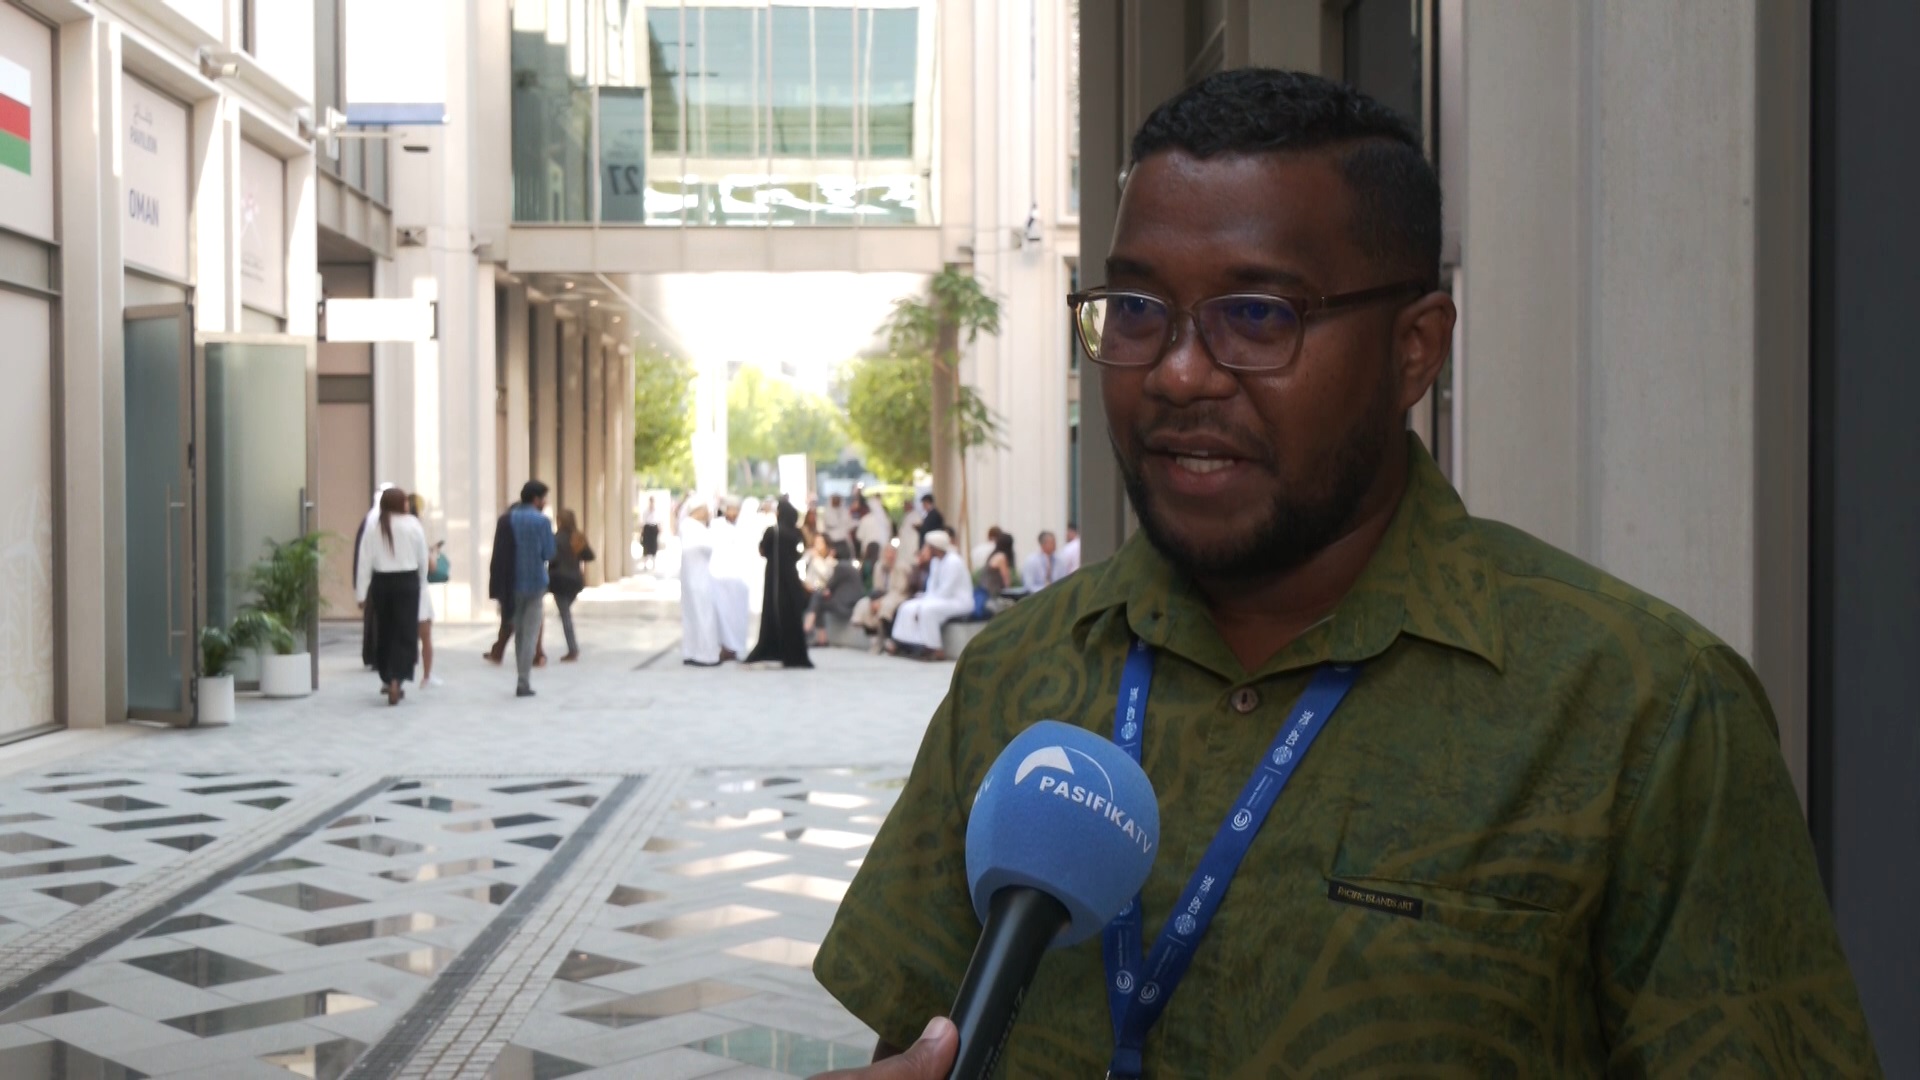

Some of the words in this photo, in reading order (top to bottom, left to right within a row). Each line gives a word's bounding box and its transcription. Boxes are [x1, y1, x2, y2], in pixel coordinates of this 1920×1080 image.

[129, 188, 159, 227] OMAN
[1337, 885, 1365, 901] PACIFIC
[1365, 894, 1397, 909] ISLANDS
[1397, 900, 1413, 912] ART
